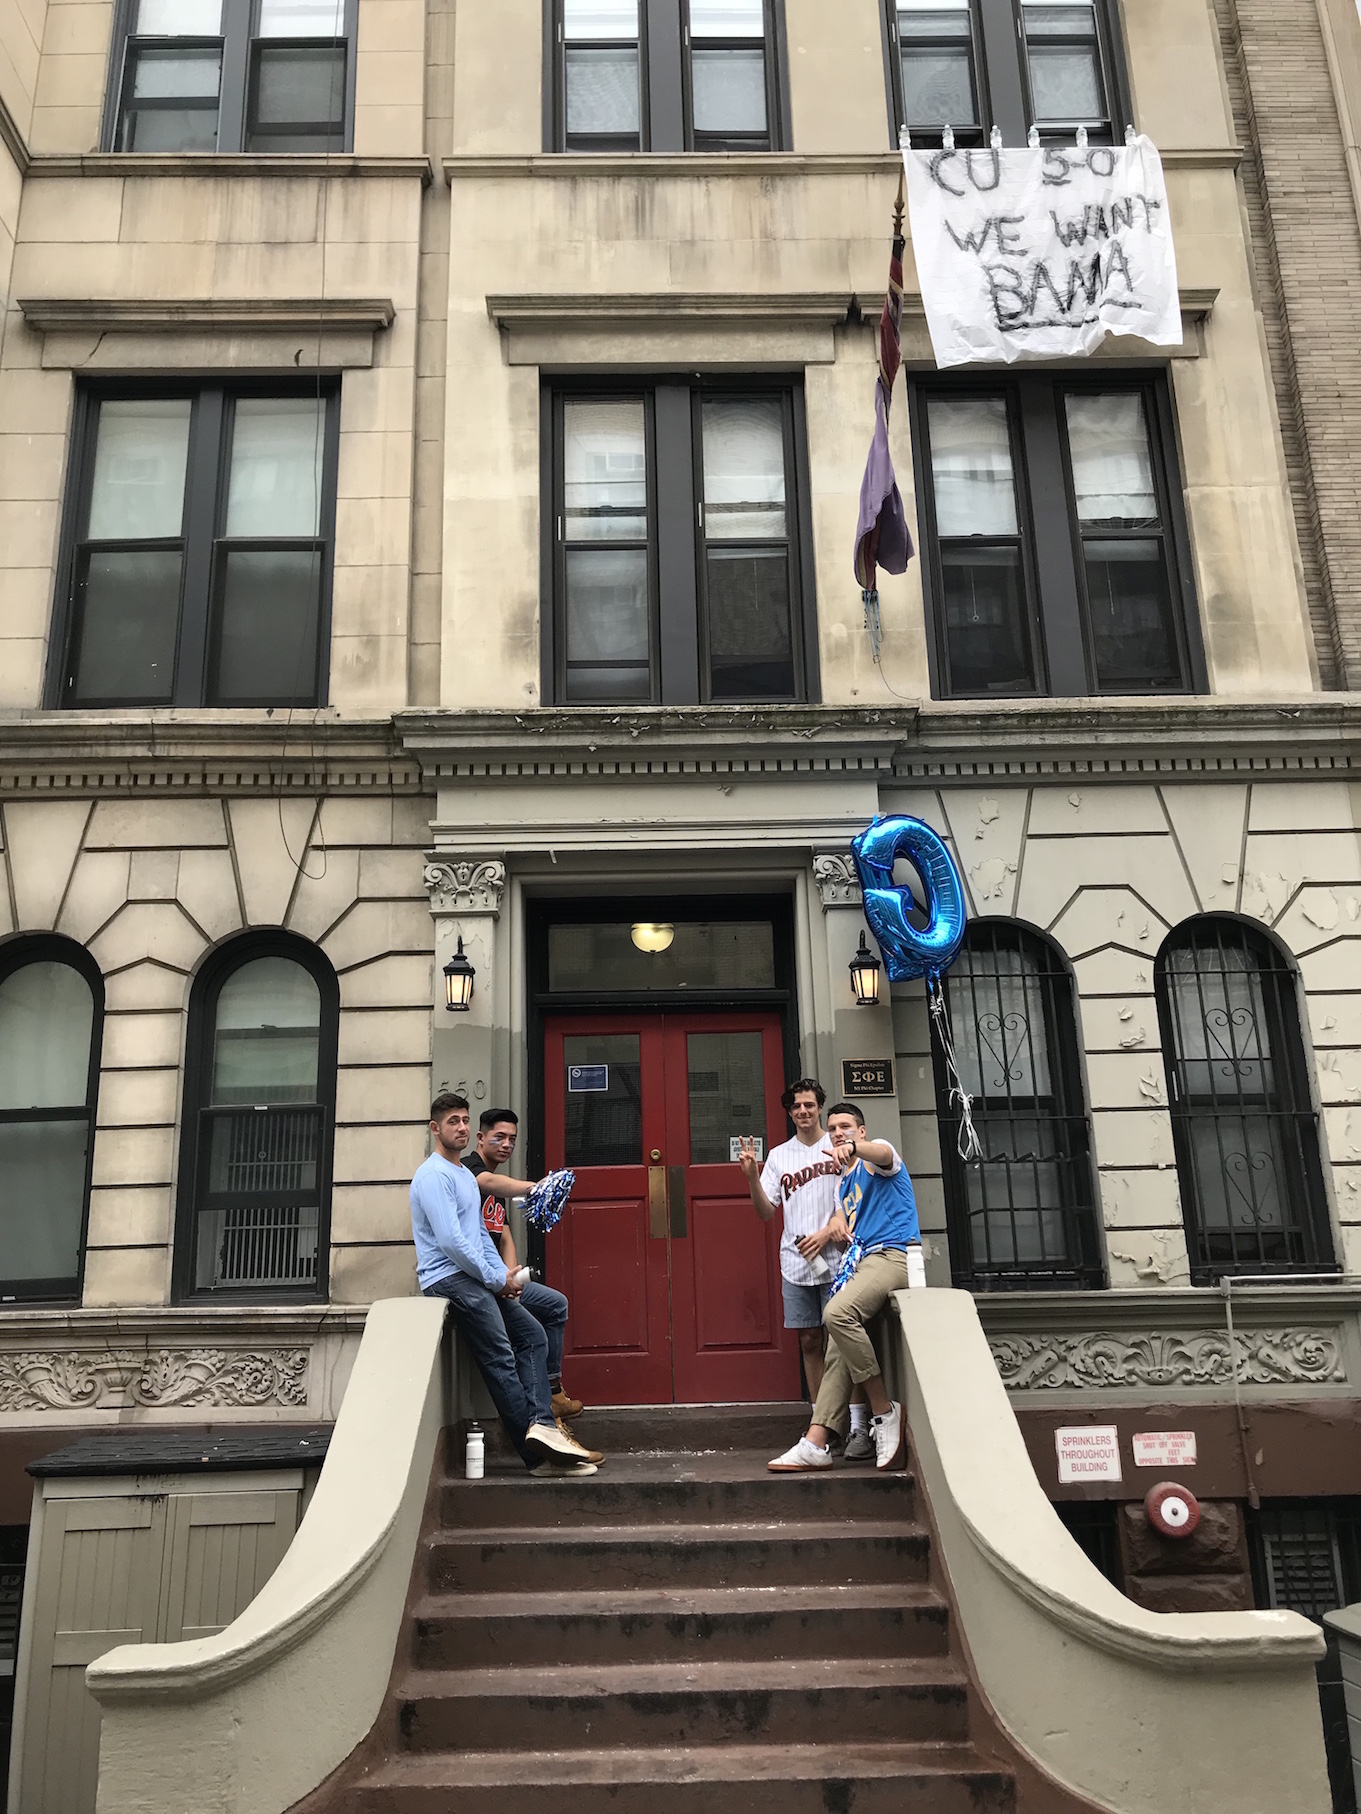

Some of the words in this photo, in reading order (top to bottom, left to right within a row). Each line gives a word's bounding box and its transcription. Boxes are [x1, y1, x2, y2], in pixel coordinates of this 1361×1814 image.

[929, 149, 1000, 196] CU
[944, 215, 1028, 255] WE
[1062, 1435, 1112, 1446] SPRINKLERS
[1142, 1441, 1156, 1449] SHUT
[1159, 1441, 1168, 1449] OFF
[1061, 1448, 1115, 1460] THROUGHOUT
[1138, 1457, 1163, 1465] OPPOSITE
[1166, 1456, 1178, 1464] THIS
[1071, 1462, 1108, 1472] BUILDING
